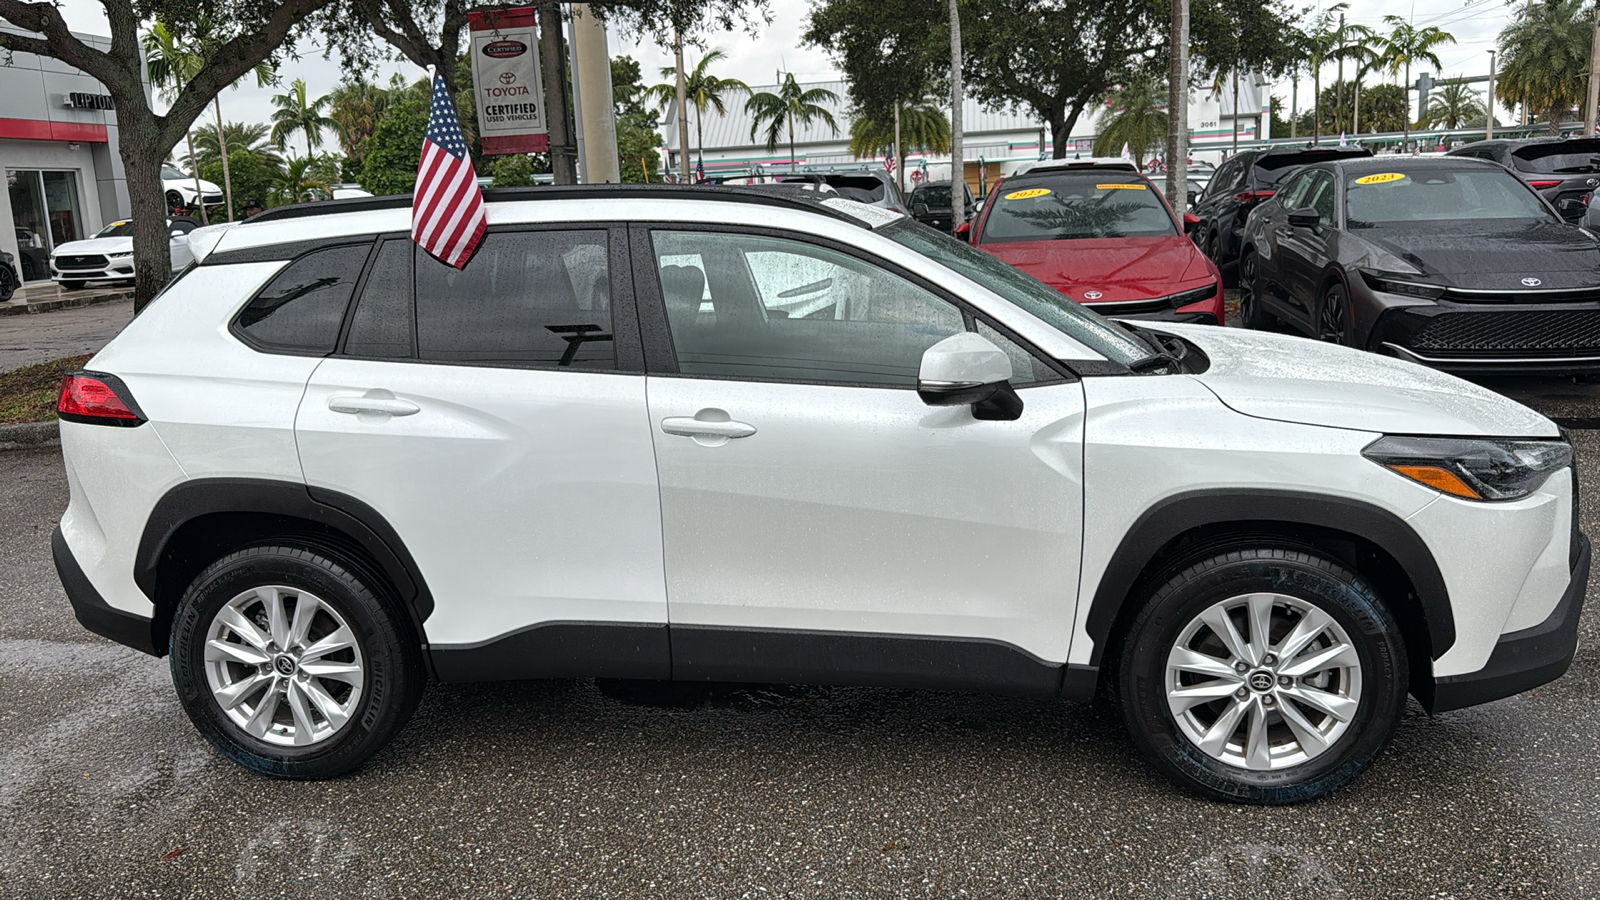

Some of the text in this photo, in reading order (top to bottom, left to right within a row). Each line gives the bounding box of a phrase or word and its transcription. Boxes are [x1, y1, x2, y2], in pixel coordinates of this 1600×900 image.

[484, 86, 530, 97] TOYOTA
[485, 103, 536, 116] CERTIFIED
[486, 113, 538, 123] USED VEHICLES
[179, 610, 196, 676] MICHELIN
[1376, 640, 1393, 681] PRIMACY
[364, 660, 384, 728] MICHELIN
